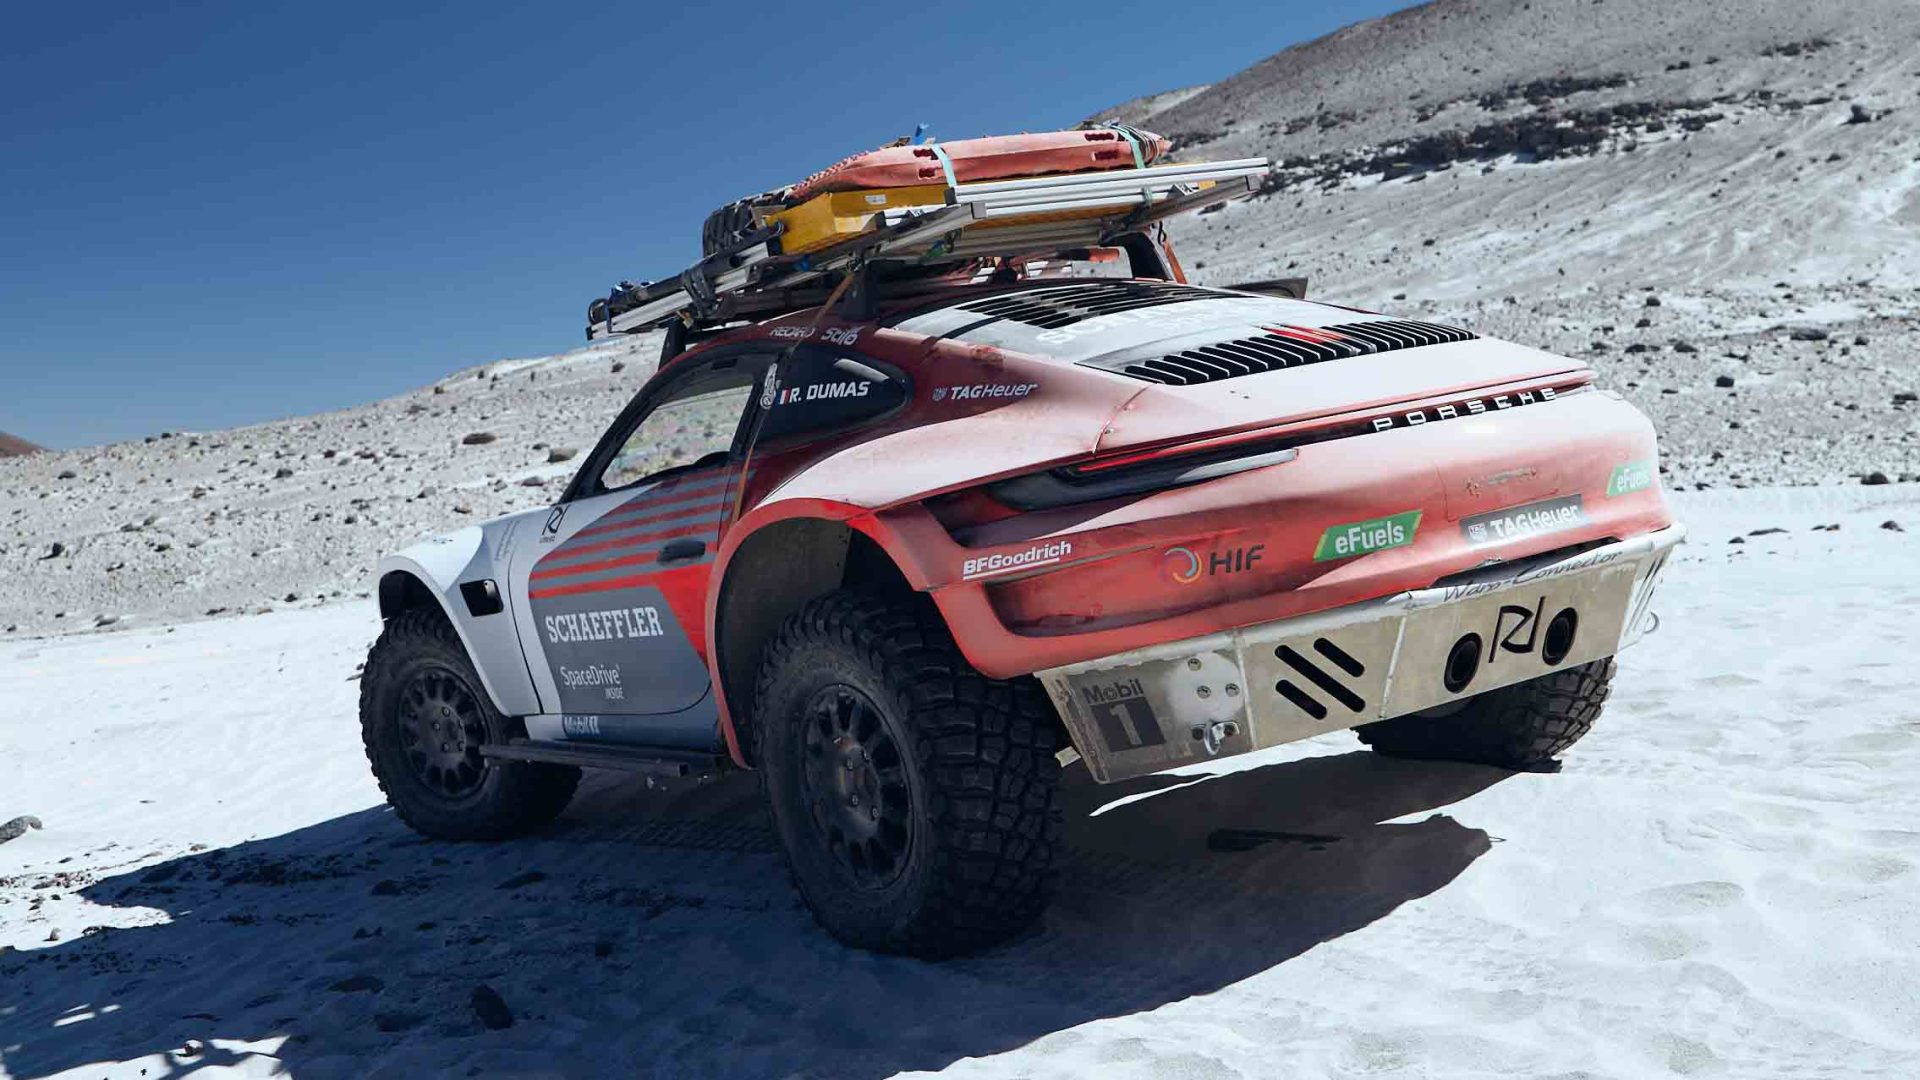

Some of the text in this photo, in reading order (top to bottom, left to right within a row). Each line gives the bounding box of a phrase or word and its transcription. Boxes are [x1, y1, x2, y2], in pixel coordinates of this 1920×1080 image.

[789, 381, 871, 403] R. DUMAS
[1372, 387, 1558, 433] PORSCHE
[1335, 520, 1404, 554] eFuels
[963, 540, 1072, 576] BFGoodrich
[1209, 544, 1265, 576] HIF
[545, 606, 664, 643] SCHAEFFLER
[1082, 678, 1144, 704] Mobil
[1109, 703, 1143, 746] 1
